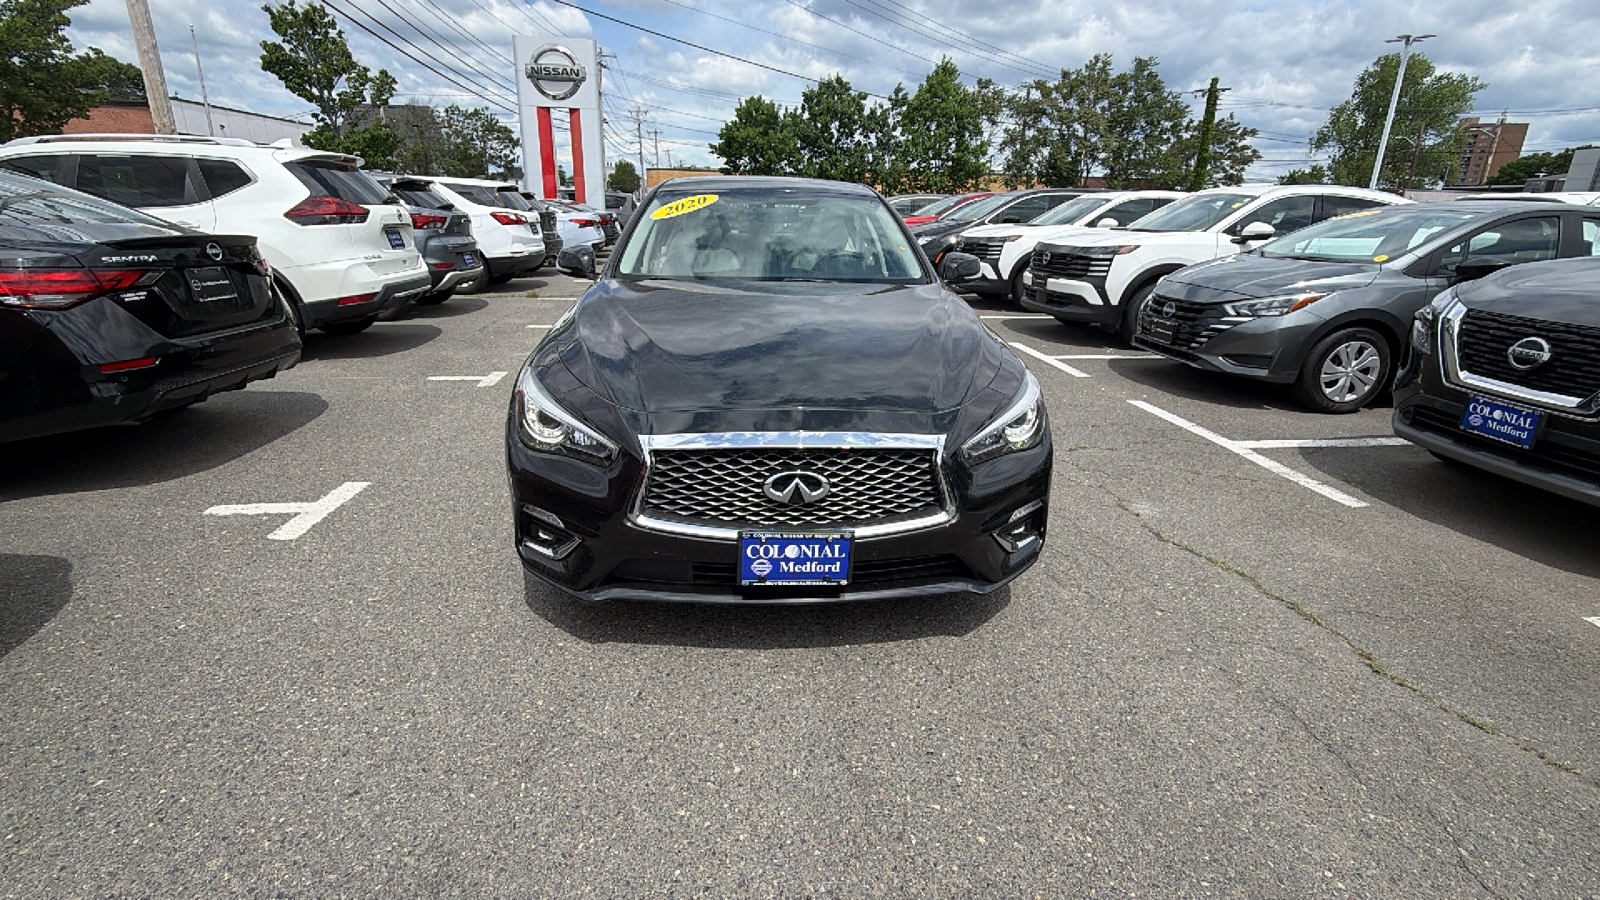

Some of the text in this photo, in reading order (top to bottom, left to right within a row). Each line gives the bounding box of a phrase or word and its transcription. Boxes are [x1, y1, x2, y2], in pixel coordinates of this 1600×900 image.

[530, 66, 580, 77] NISSAN
[664, 196, 708, 216] 2020
[101, 254, 159, 264] SENTRA
[1512, 348, 1544, 359] NISSAN
[1469, 402, 1534, 429] COLONIAL
[1486, 420, 1528, 439] Medford
[746, 544, 846, 559] COLONIAL
[780, 561, 841, 573] Medford
